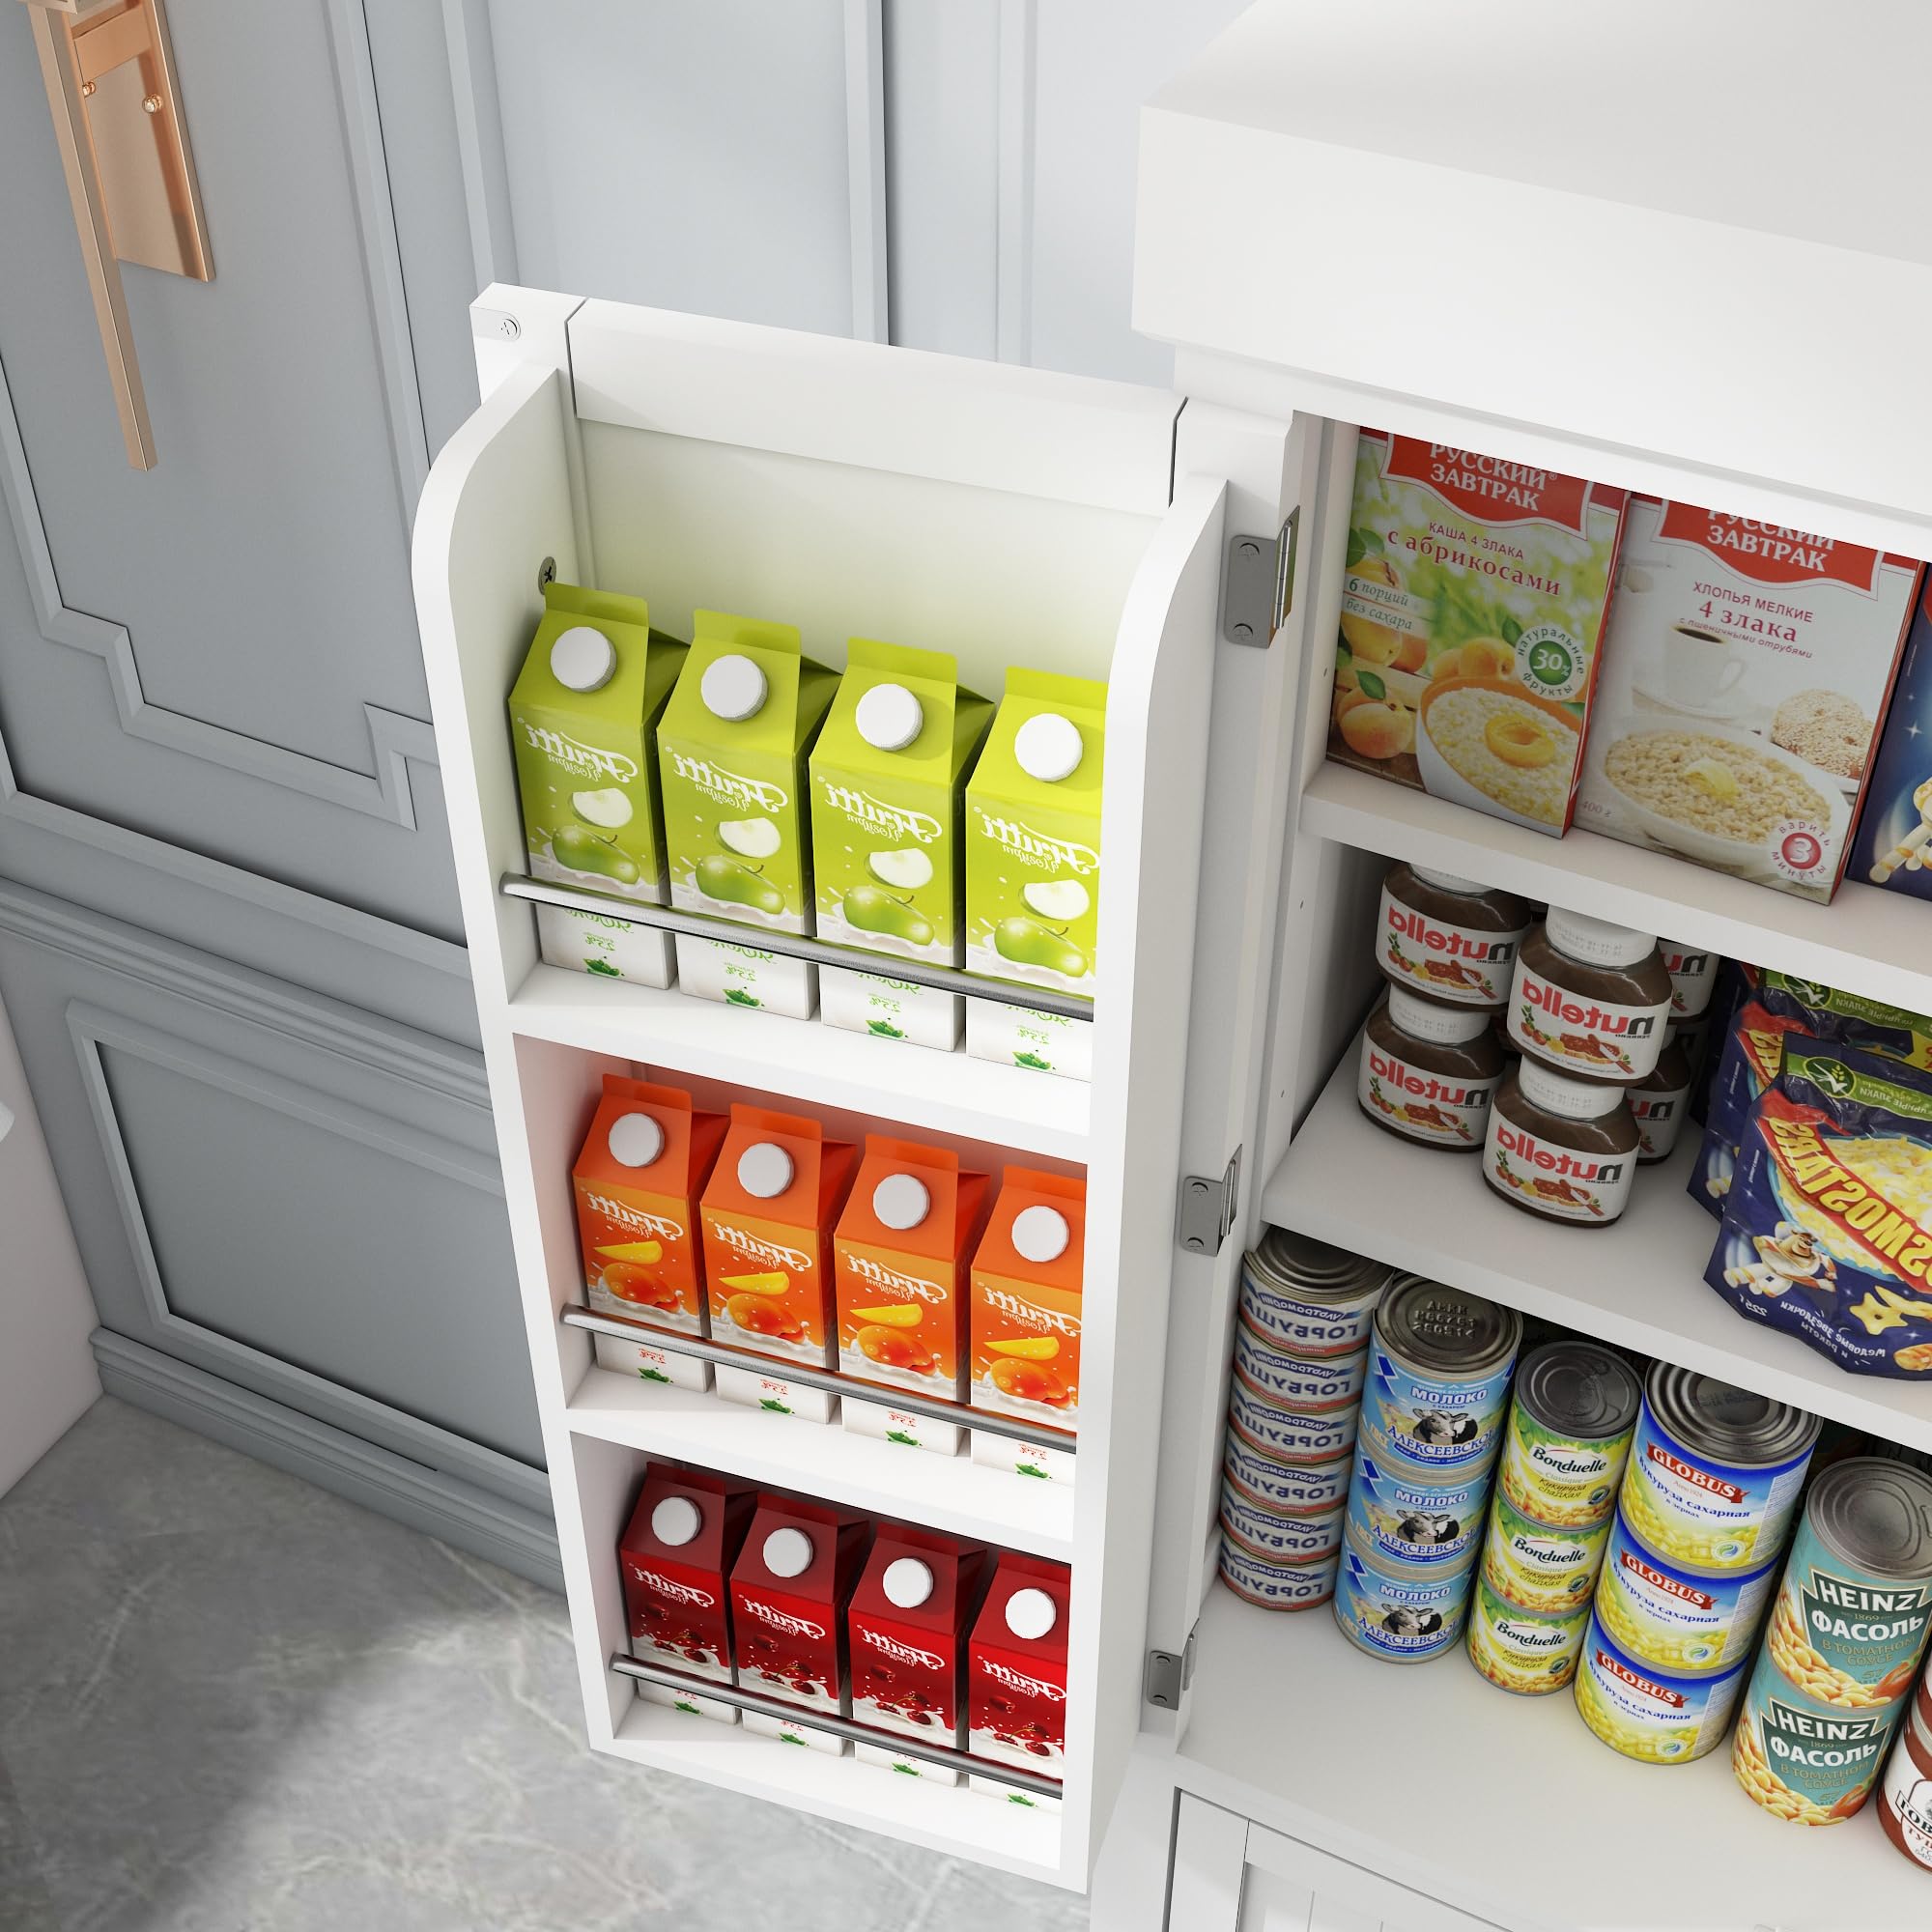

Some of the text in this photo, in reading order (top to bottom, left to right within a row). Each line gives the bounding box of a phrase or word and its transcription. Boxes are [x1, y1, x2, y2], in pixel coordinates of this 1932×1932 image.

[1430, 463, 1541, 512] ЗАВТРАК
[1429, 522, 1524, 560] КАША 4 ЗЛАКА
[1706, 525, 1828, 573] ЗАВТРАК
[1387, 530, 1562, 596] с абрикосами
[1349, 577, 1409, 607] 6 порций
[1692, 581, 1814, 623] ХЛОПЬЯ МЕЛКИЕ
[1346, 597, 1413, 631] без сахара
[1698, 600, 1798, 642] 4 злака
[1517, 628, 1585, 675] натуральные
[1687, 619, 1757, 644] пшеничными
[1757, 639, 1813, 659] отрубями
[1522, 671, 1574, 696] фрукты
[1777, 820, 1832, 847] варить
[1789, 837, 1812, 864] 3
[1770, 850, 1827, 881] минуты
[1410, 1385, 1489, 1405] МОЛОКО
[1531, 1446, 1607, 1474] Bonduelle
[1652, 1448, 1737, 1499] GLOBUS
[1545, 1470, 1583, 1485] Classique
[1638, 1454, 1752, 1520] Кукуруза сахарная
[1394, 1488, 1470, 1507] МОЛОКО
[1671, 1500, 1700, 1520] зернах
[1513, 1536, 1587, 1564] Bonduelle
[1525, 1559, 1563, 1573] Classique
[1625, 1554, 1706, 1605] GLOBUS
[1378, 1582, 1452, 1602] МОЛОКО
[1612, 1561, 1656, 1609] Кукуруза
[1658, 1605, 1720, 1624] сахарная
[1817, 1577, 1918, 1612] HEINZ
[1645, 1606, 1672, 1624] зернах
[1810, 1608, 1924, 1643] ФАСОЛЬ
[1853, 1612, 1880, 1622] 1869
[1495, 1620, 1567, 1647] Bonduelle
[1822, 1635, 1917, 1658] В ТОМАТНОМ
[1508, 1643, 1545, 1656] Classique
[1846, 1652, 1893, 1667] СОУСЕ
[1588, 1658, 1630, 1706] Кукуруза
[1632, 1703, 1691, 1720] сахарная
[1601, 1655, 1678, 1704] GLOBUS
[1618, 1703, 1645, 1720] зернах
[1773, 1706, 1873, 1740] HEINZ
[1769, 1735, 1878, 1770] ФАСОЛЬ
[1809, 1739, 1835, 1749] 1869
[1780, 1761, 1870, 1781] В ТОМАТНОМ
[1804, 1776, 1848, 1790] СОУСЕ
